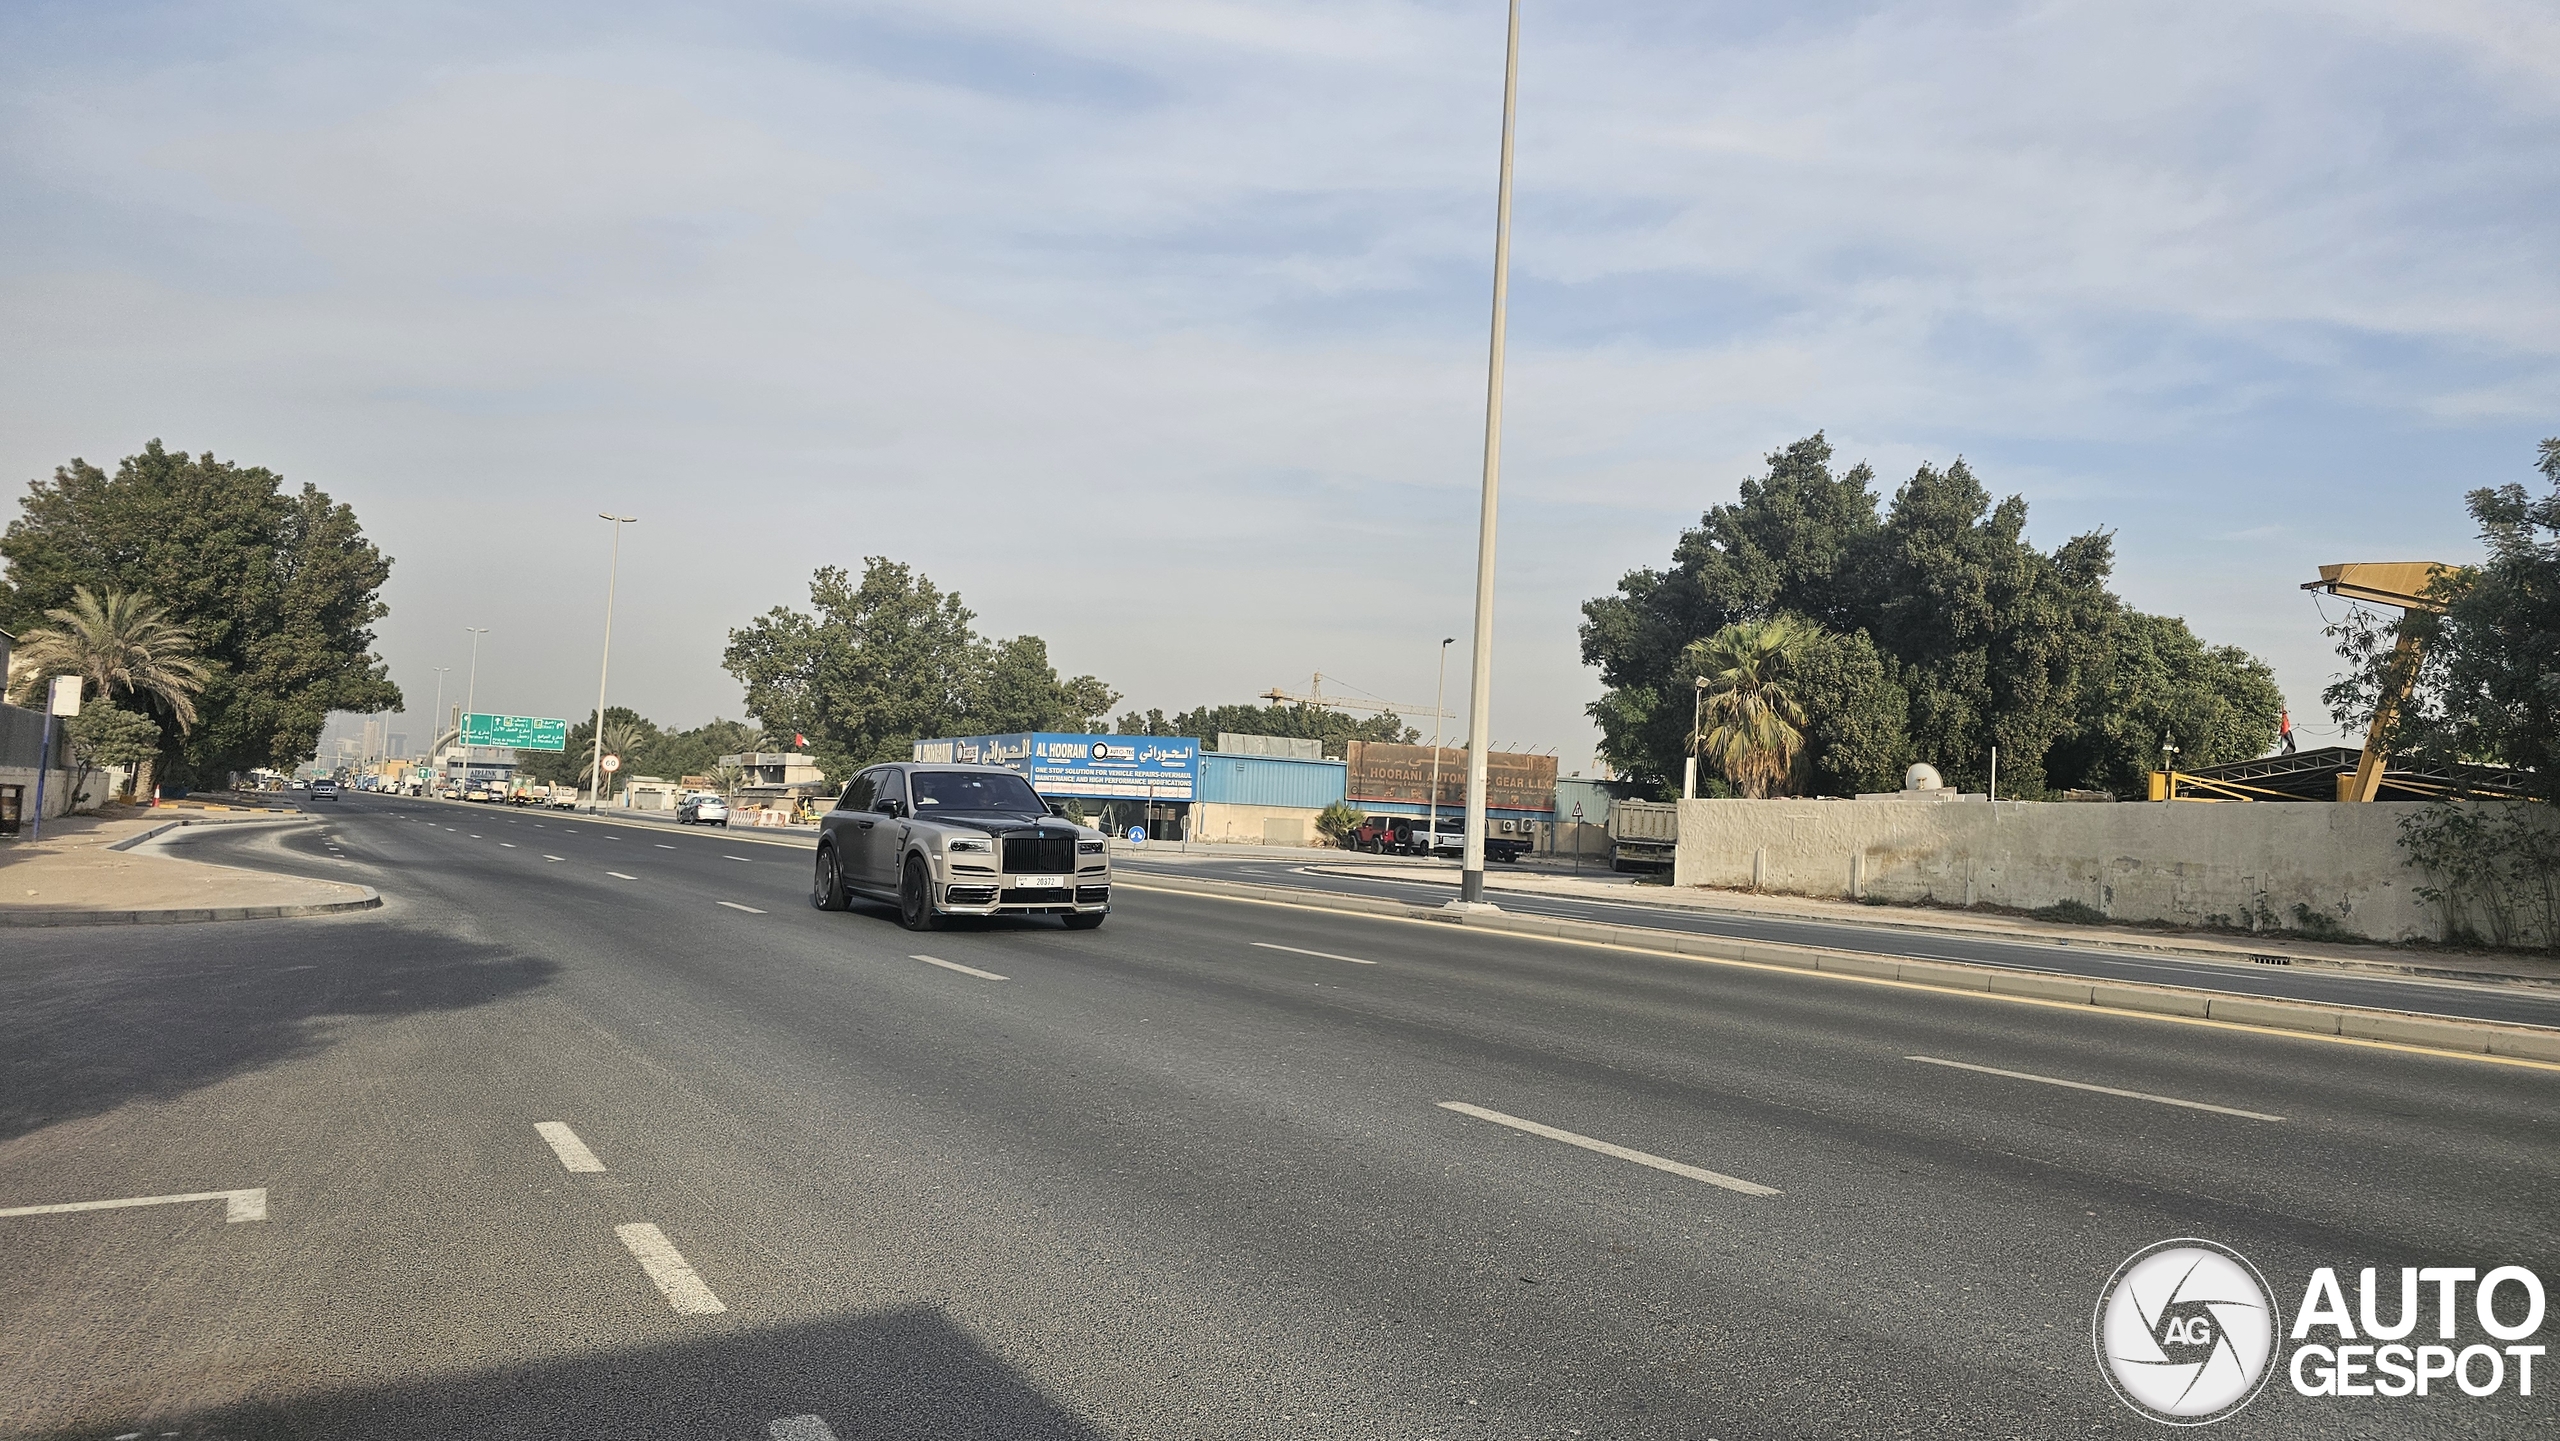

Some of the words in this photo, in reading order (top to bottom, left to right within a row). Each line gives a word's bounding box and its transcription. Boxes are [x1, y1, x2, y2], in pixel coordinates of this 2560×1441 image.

[1035, 742, 1047, 757] AL
[1049, 743, 1088, 759] HOORANI
[1139, 744, 1192, 763] الحوراني
[1148, 779, 1192, 787] MODIFICATIONS
[1370, 767, 1422, 780] HOORANI
[1496, 776, 1524, 788] GEAR
